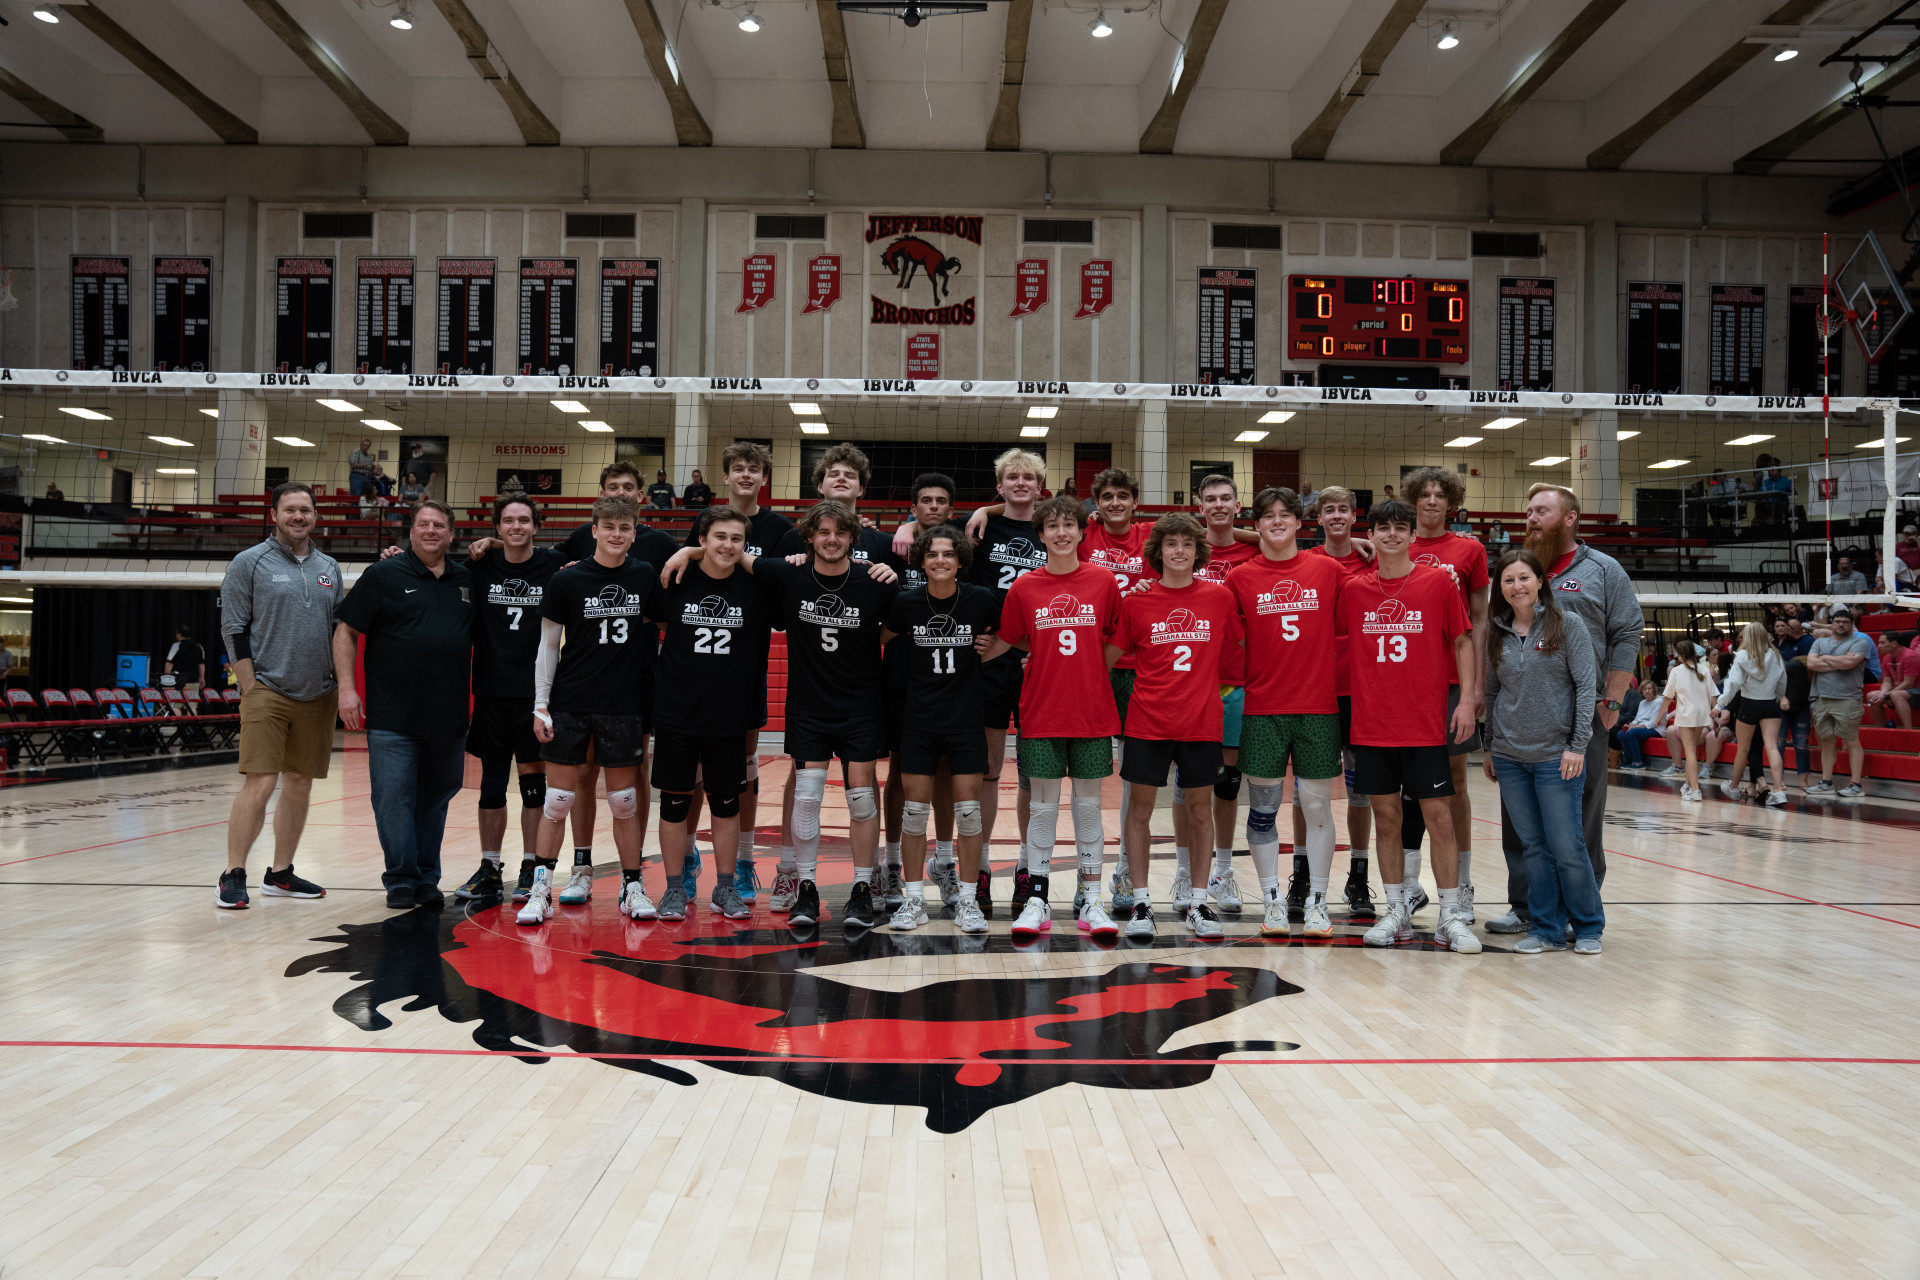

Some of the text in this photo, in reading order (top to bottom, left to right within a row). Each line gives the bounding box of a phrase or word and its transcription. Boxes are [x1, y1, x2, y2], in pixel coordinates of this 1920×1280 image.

[865, 215, 983, 246] JEFFERSON
[532, 260, 565, 268] TENNIS
[522, 268, 575, 276] CHAMPIONS
[603, 268, 656, 276] CHAMPIONS
[1216, 270, 1238, 278] GOLF
[1200, 278, 1254, 286] CHAMPIONS
[1516, 280, 1538, 288] GOLF
[1304, 279, 1458, 304] Home 1:00 Guests
[1502, 287, 1552, 296] CHAMPIONS
[871, 294, 975, 325] BRONCHOS
[1318, 294, 1332, 319] 0
[1448, 298, 1463, 322] 0
[1361, 313, 1412, 331] period 0
[1296, 336, 1334, 356] fouls 0
[1344, 342, 1367, 352] player
[1446, 346, 1463, 355] fouls
[112, 372, 162, 383] IBVCA
[260, 374, 311, 386] IBVCA
[409, 375, 459, 386] IBVCA
[559, 376, 609, 388] IBVCA
[711, 378, 762, 390] IBVCA
[864, 380, 915, 392] IBVCA
[1018, 382, 1069, 394] IBVCA
[1171, 385, 1222, 397] IBVCA
[1321, 388, 1371, 400] IBVCA
[1470, 391, 1518, 403] IBVCA
[1615, 395, 1663, 406] IBVCA
[1758, 397, 1806, 408] IBVCA
[496, 446, 566, 454] RESTROOMS
[749, 546, 762, 556] 23
[854, 551, 868, 560] 23
[992, 543, 1047, 560] 20 23
[1092, 549, 1106, 558] 20
[990, 554, 1016, 562] INDIANA
[905, 569, 918, 578] 20
[998, 565, 1032, 589] 2
[489, 584, 543, 596] 20 23
[1257, 588, 1318, 603] 20 23
[584, 594, 640, 607] 20 23
[684, 603, 742, 616] 20 23
[800, 600, 860, 616] 20 23
[1036, 604, 1094, 618] 20 23
[1258, 604, 1286, 612] INDIANA
[507, 607, 524, 630] 7
[800, 614, 826, 622] INDIANA
[1364, 610, 1422, 622] 20 23
[599, 618, 629, 644] 13
[912, 624, 972, 635] 20 23
[1152, 620, 1210, 632] 20 23
[1281, 614, 1300, 642] 5
[694, 628, 732, 654] 22
[822, 628, 838, 652] 5
[1059, 630, 1077, 656] 9
[1152, 634, 1180, 642] INDIANA
[1376, 635, 1408, 662] 13
[932, 648, 956, 674] 11
[1173, 646, 1192, 672] 2
